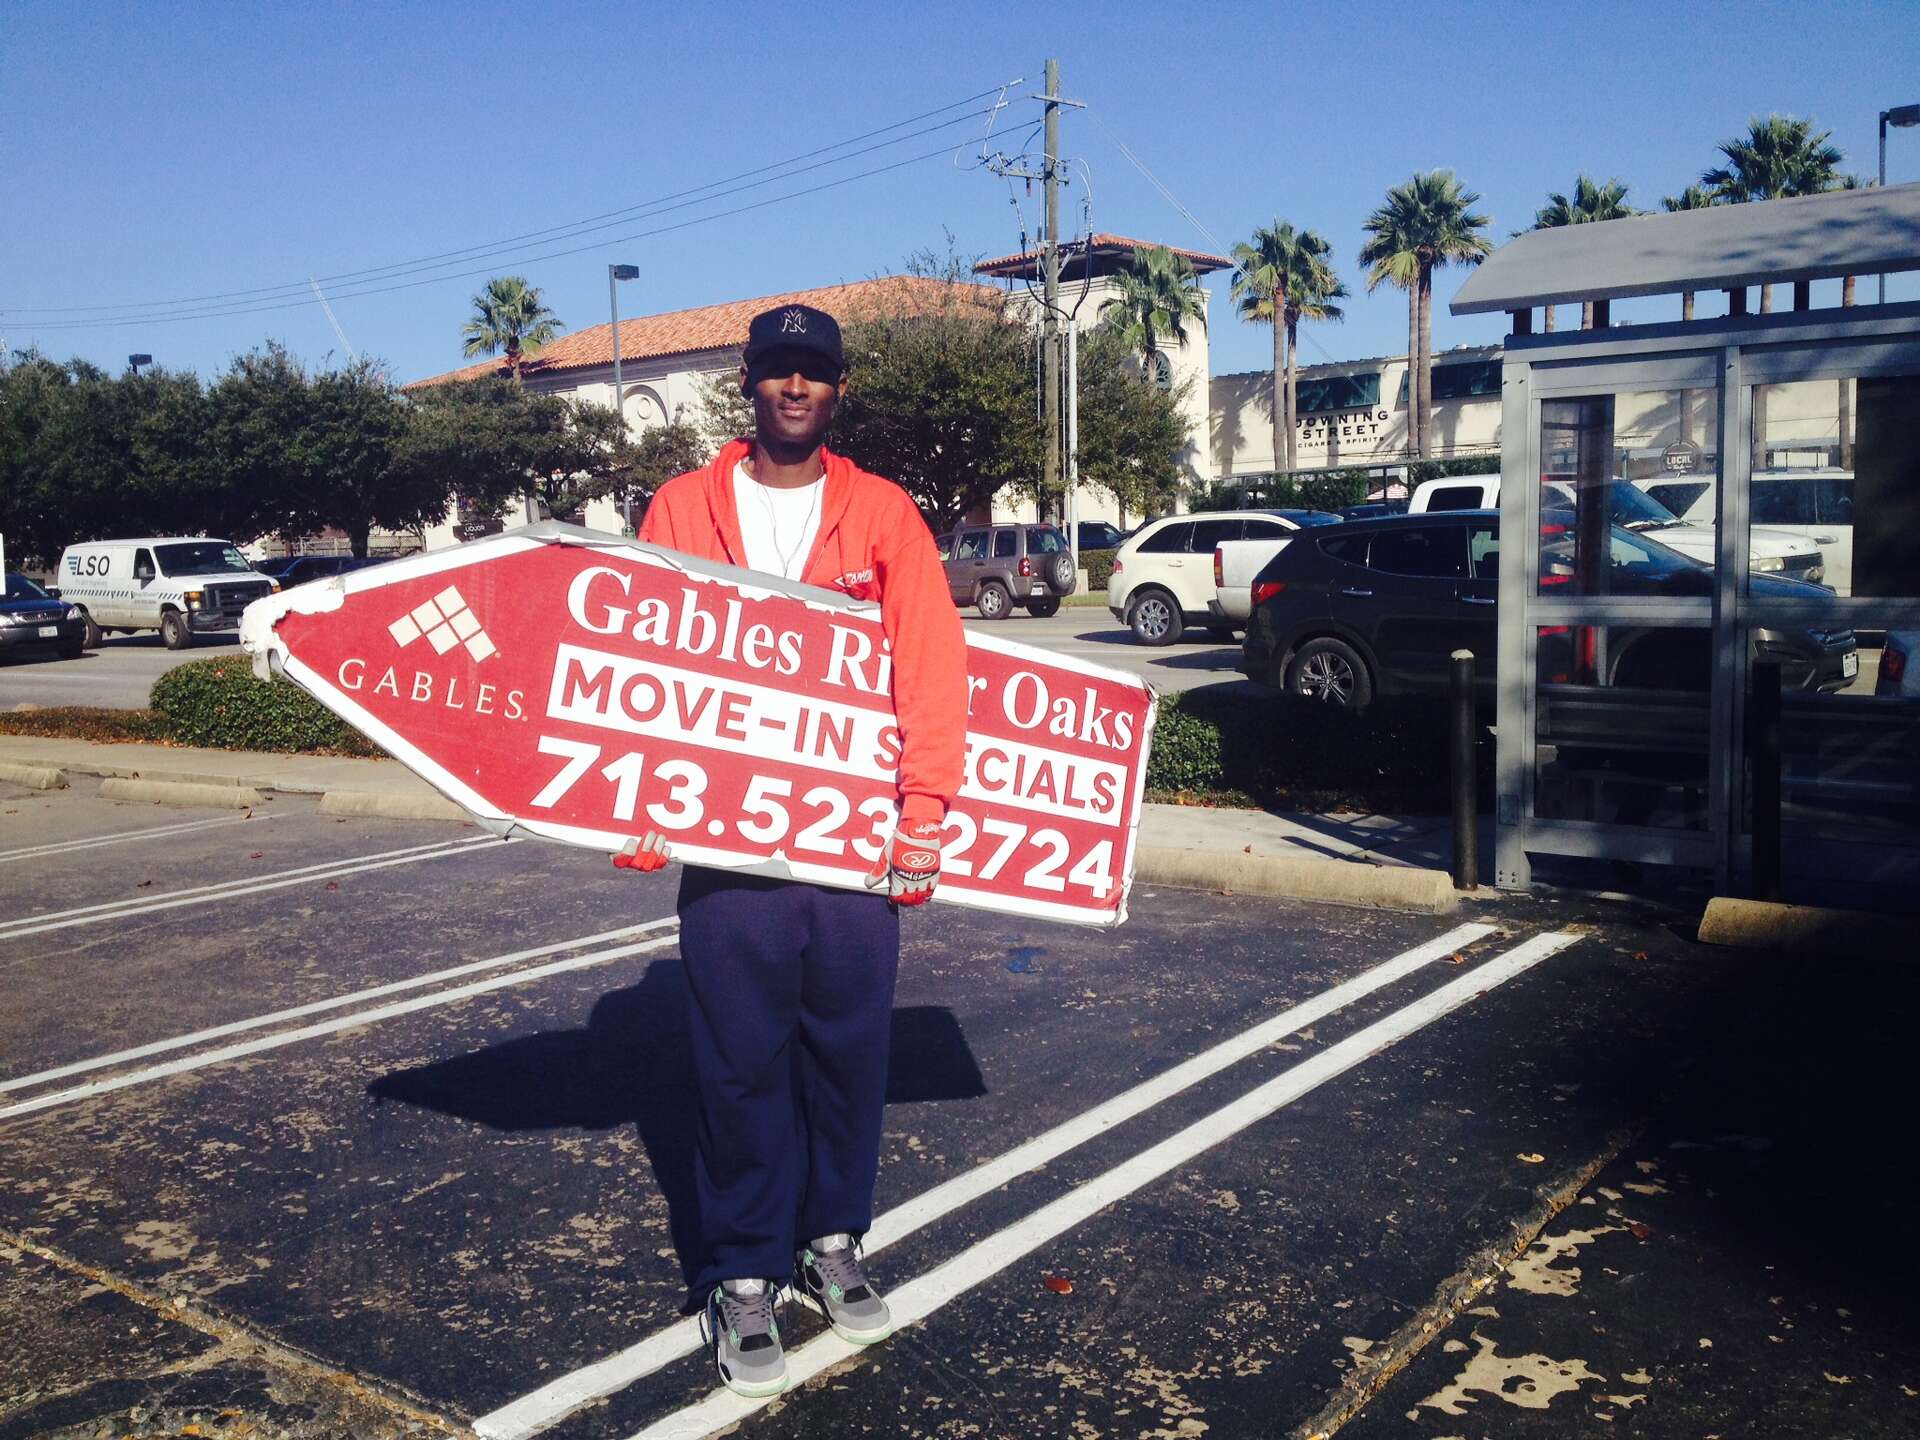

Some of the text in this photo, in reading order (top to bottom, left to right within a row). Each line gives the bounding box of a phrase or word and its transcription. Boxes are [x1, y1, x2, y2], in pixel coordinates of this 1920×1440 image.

[1297, 440, 1332, 448] CIGARS
[1346, 437, 1385, 445] SPIRITS
[1302, 424, 1379, 439] STREET
[1666, 455, 1693, 465] LOCAL
[76, 555, 111, 576] LSO
[567, 566, 1134, 751] Gables Rir Oaks
[338, 658, 525, 720] GABLES
[560, 658, 1117, 814] MOVE-IN SCIALS
[529, 735, 1115, 899] 713.5232724
